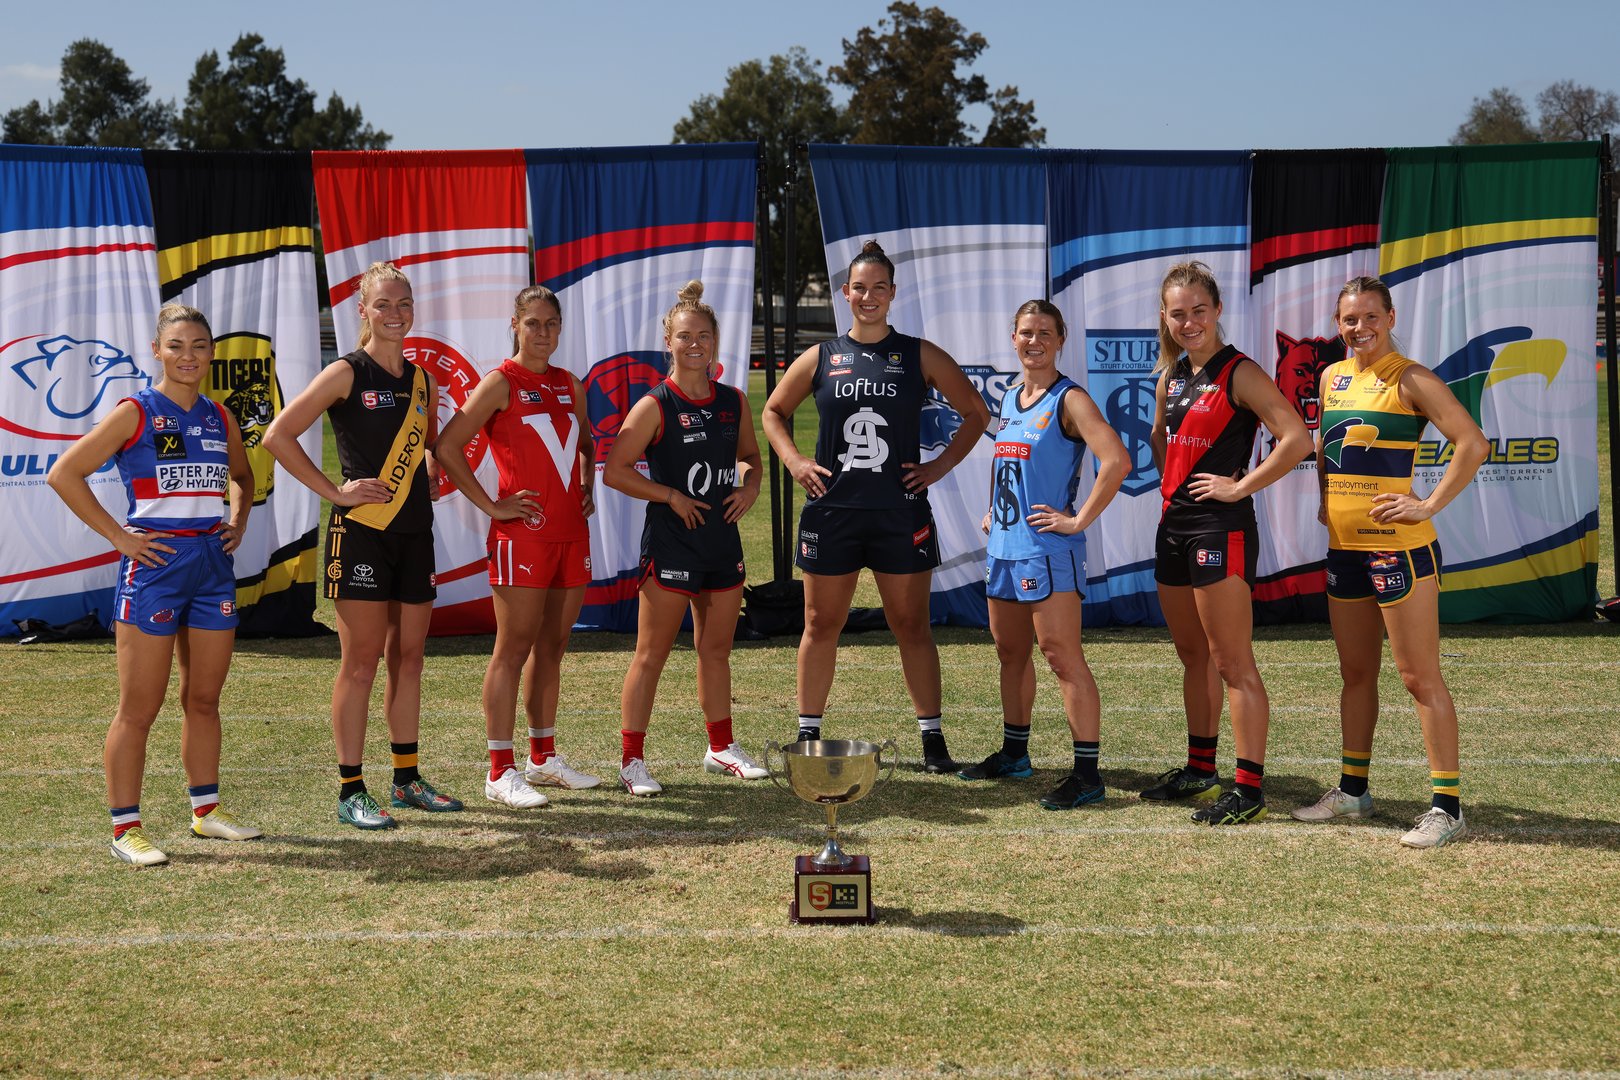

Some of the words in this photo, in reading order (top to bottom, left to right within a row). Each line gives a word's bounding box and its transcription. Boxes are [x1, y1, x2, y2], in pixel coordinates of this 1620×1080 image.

[1094, 340, 1159, 362] STUR
[835, 378, 897, 401] loftus
[1180, 435, 1213, 448] CAPITAL
[1414, 437, 1559, 467] EALES
[160, 465, 202, 480] PETER
[1330, 479, 1379, 490] Employment
